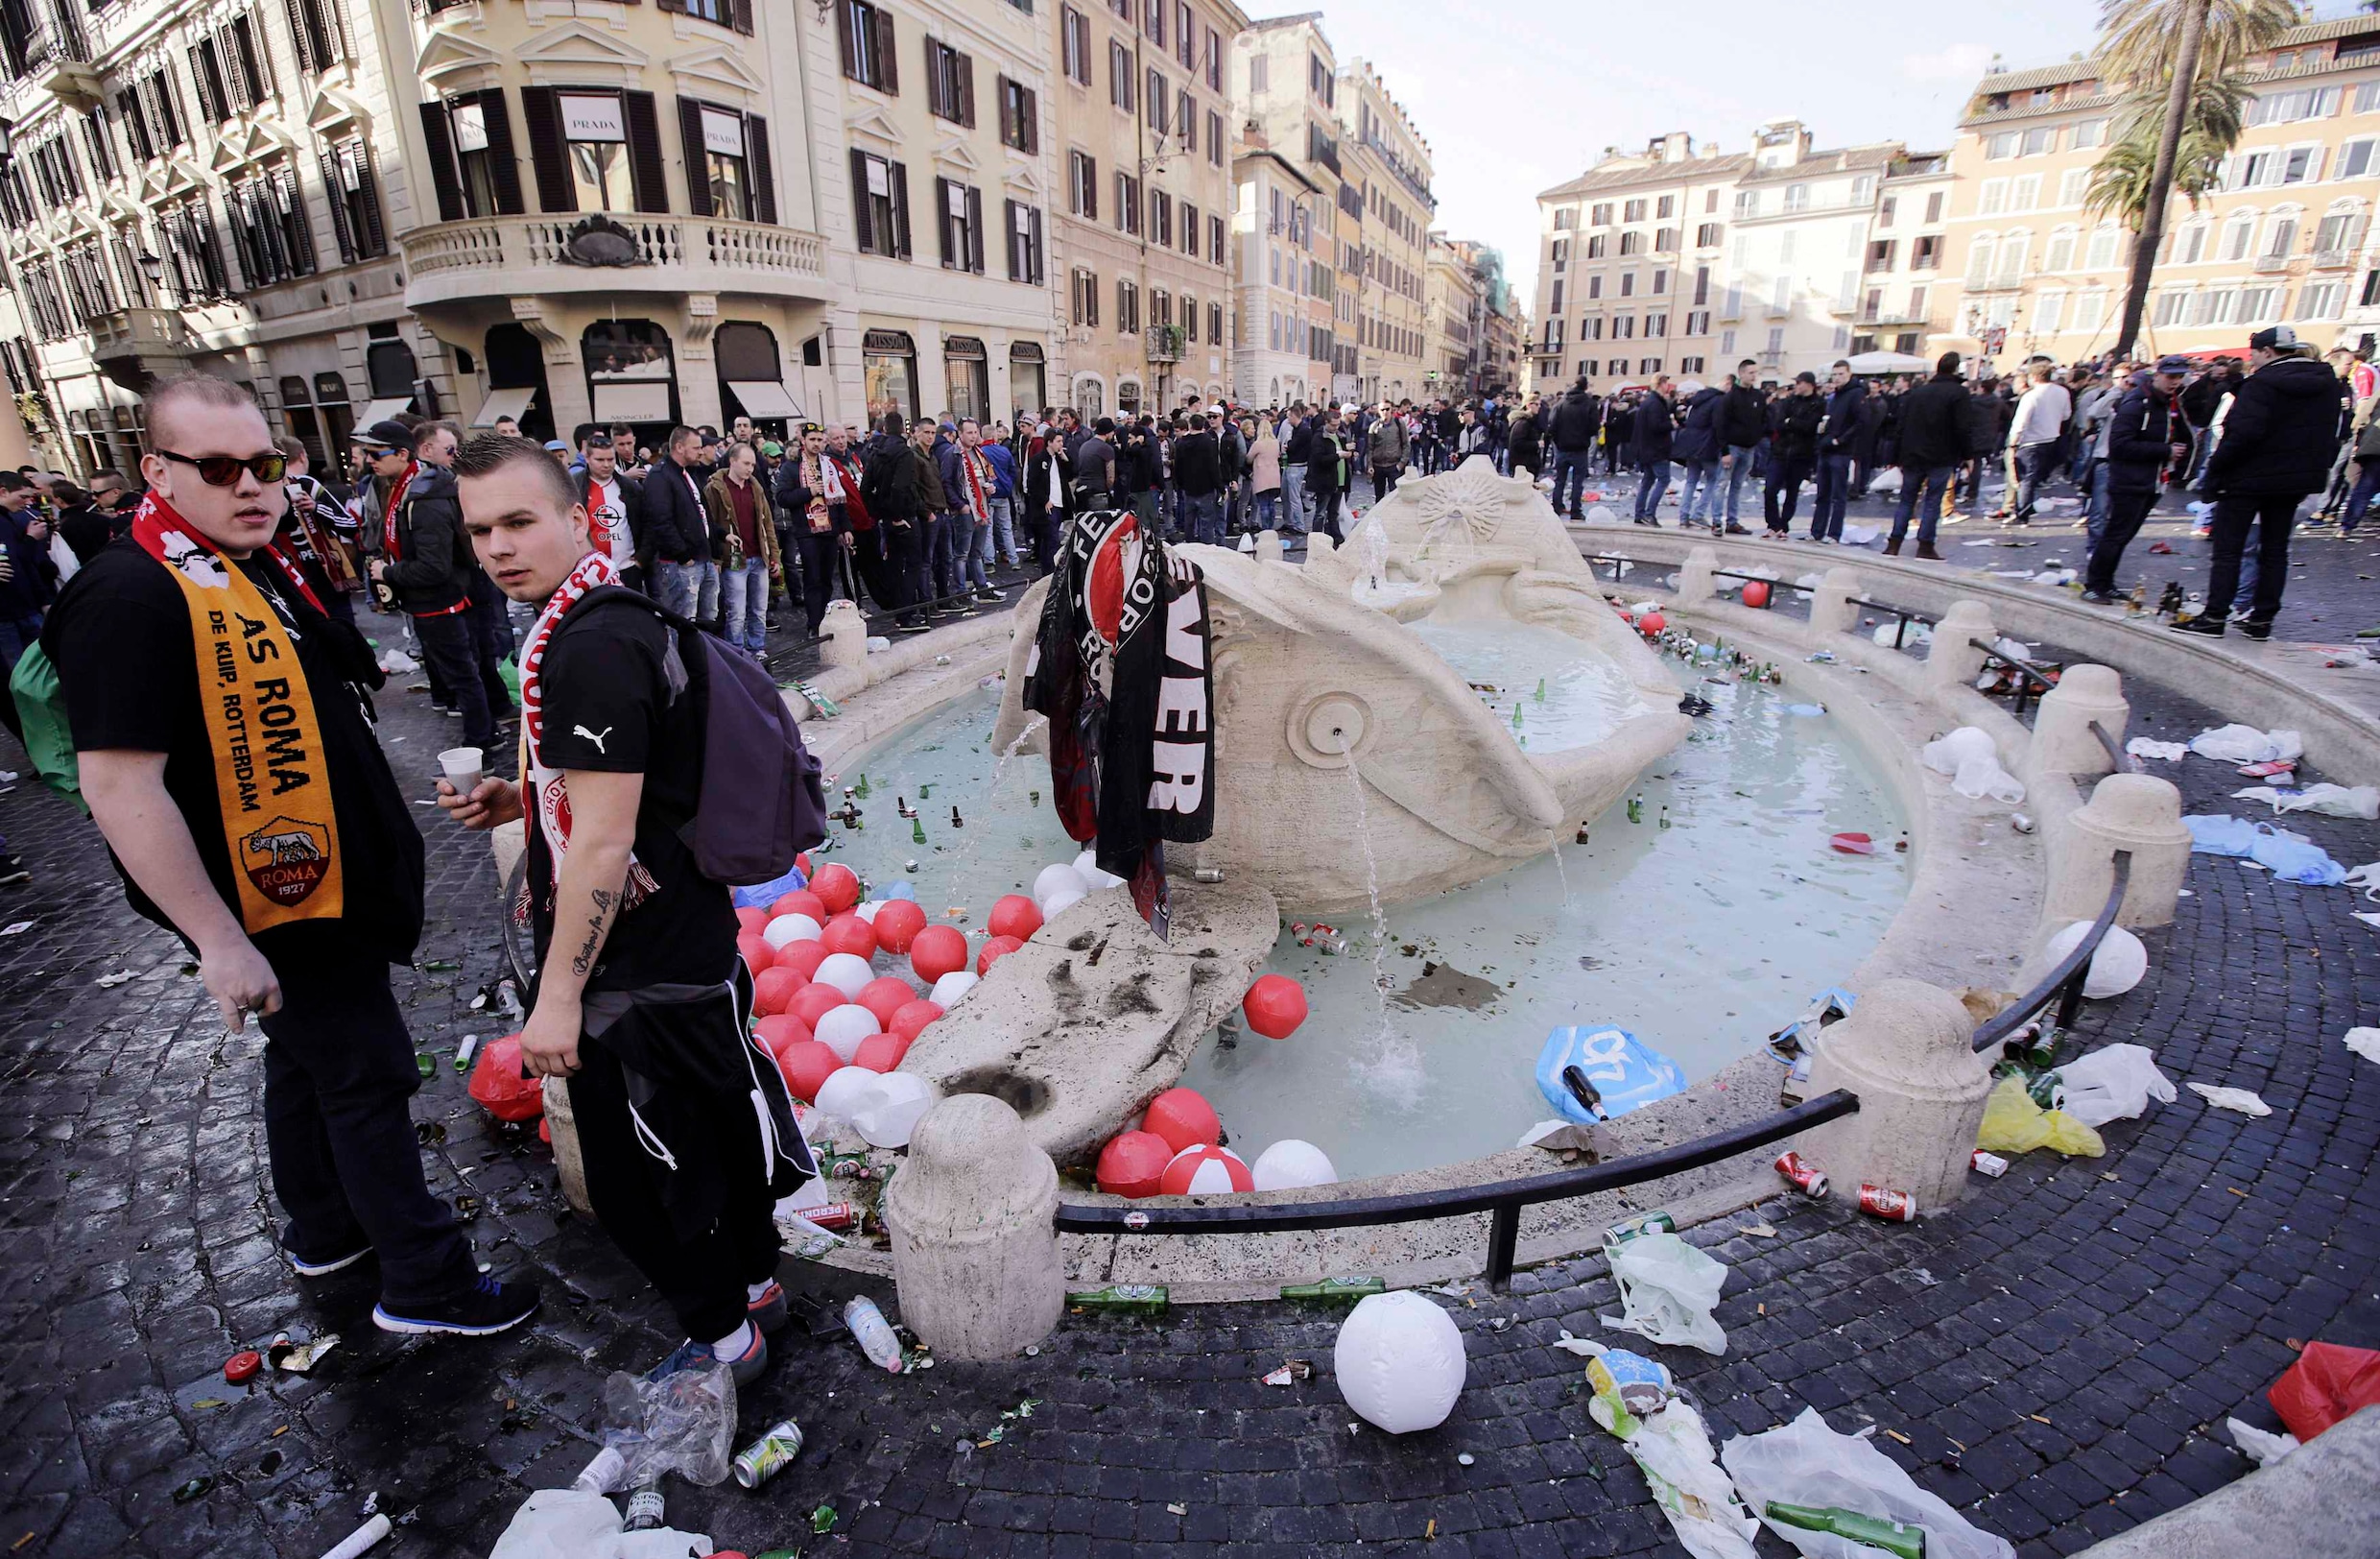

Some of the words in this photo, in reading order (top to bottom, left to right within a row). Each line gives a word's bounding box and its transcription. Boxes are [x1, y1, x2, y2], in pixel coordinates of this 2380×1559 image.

[572, 118, 617, 131] PRADA
[705, 131, 738, 146] PRADA
[868, 333, 908, 349] MISSONI
[949, 338, 982, 354] MISSONI
[609, 413, 654, 421] MONCLER
[598, 532, 623, 541] OPEL
[208, 610, 228, 636] DE
[234, 611, 280, 664] AS
[214, 640, 238, 688] KUIP,
[253, 677, 312, 797] ROMA
[223, 692, 261, 813] ROTTERDAM
[261, 864, 321, 889] ROMA
[277, 881, 306, 896] 1927
